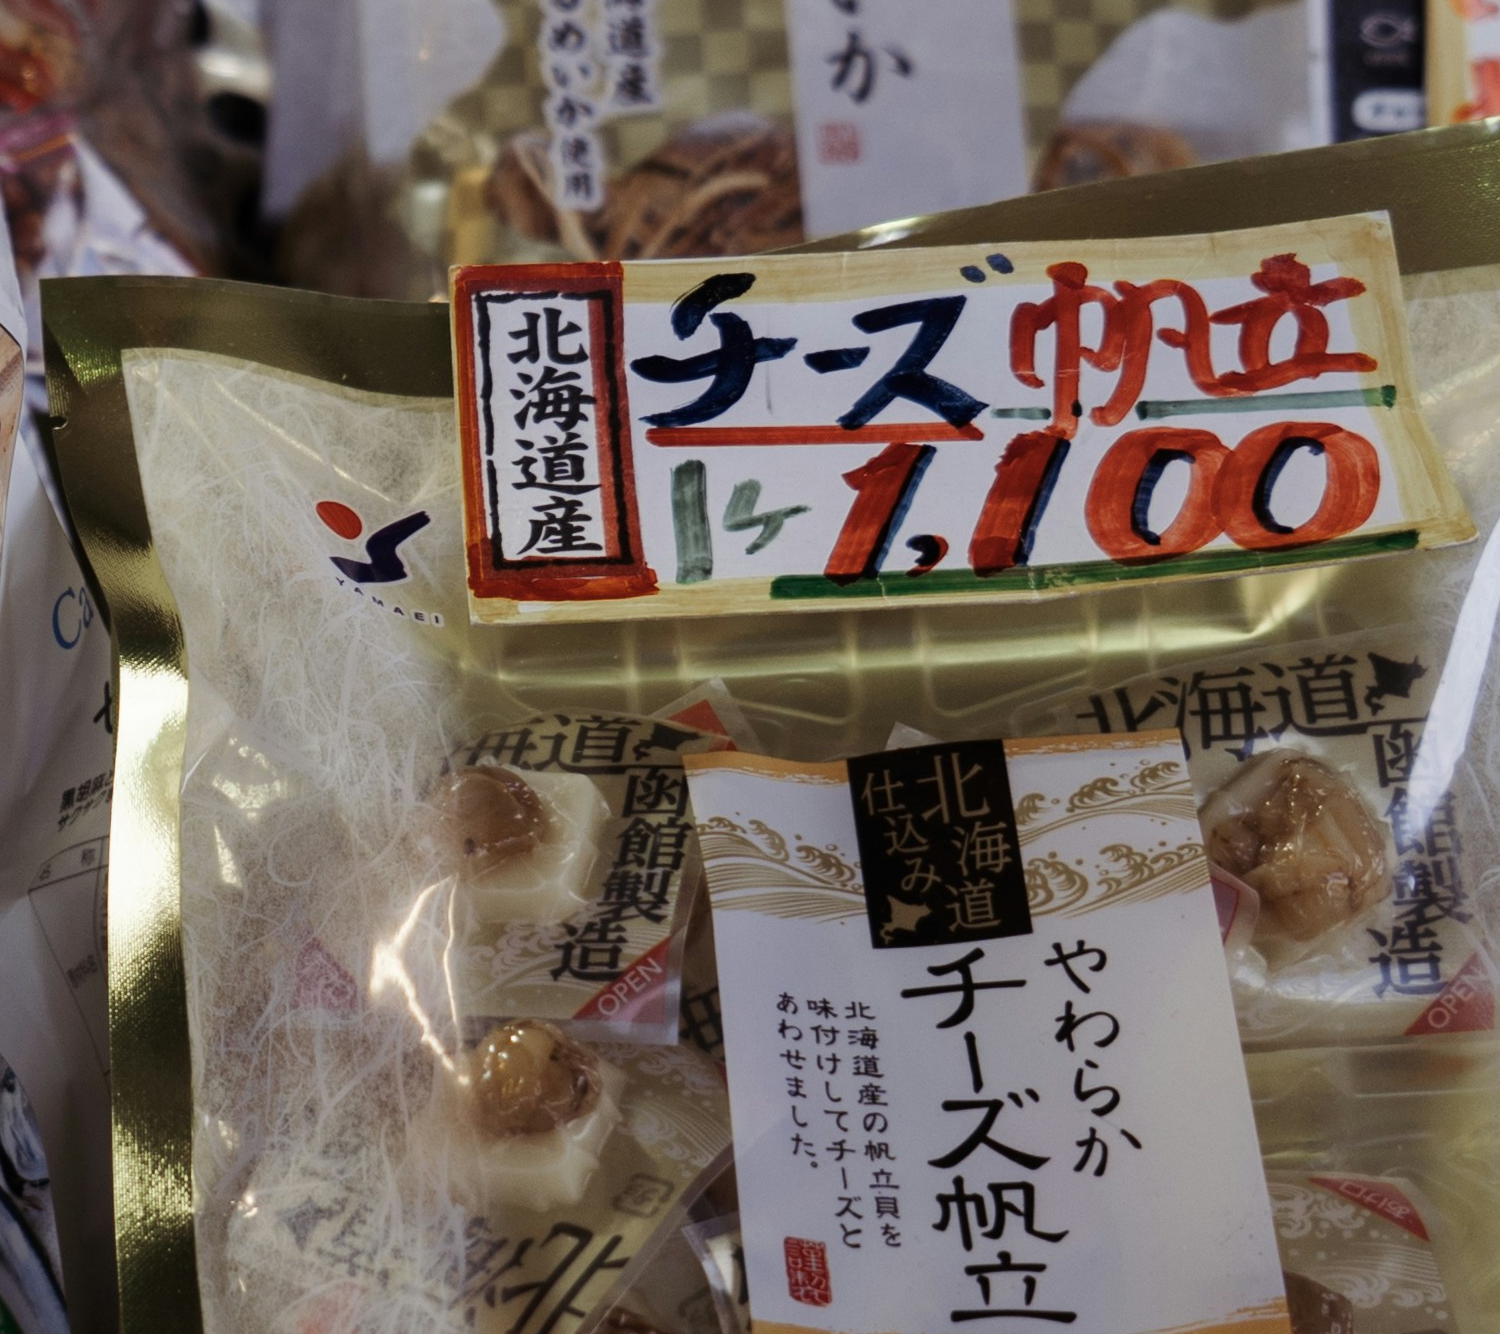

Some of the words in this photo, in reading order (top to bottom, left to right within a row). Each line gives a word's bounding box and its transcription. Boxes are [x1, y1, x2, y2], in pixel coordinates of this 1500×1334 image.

[505, 307, 603, 559] 北海道産
[630, 251, 1380, 441] チーズ帆立
[823, 417, 1382, 585] 1,100
[334, 576, 444, 626] YAMAEI
[1074, 651, 1372, 759] 北海道
[552, 767, 696, 987] 函館製造
[860, 768, 943, 895] 仕込み
[916, 751, 1014, 933] 北海道
[598, 953, 666, 1019] OPEN
[1044, 939, 1144, 1179] やわらか
[776, 991, 819, 1170] あわせました。
[806, 997, 863, 1250] 味付けしてチーズと
[844, 1000, 902, 1248] 北海道産の帆立貝を
[900, 947, 1080, 1325] チーズ帆立
